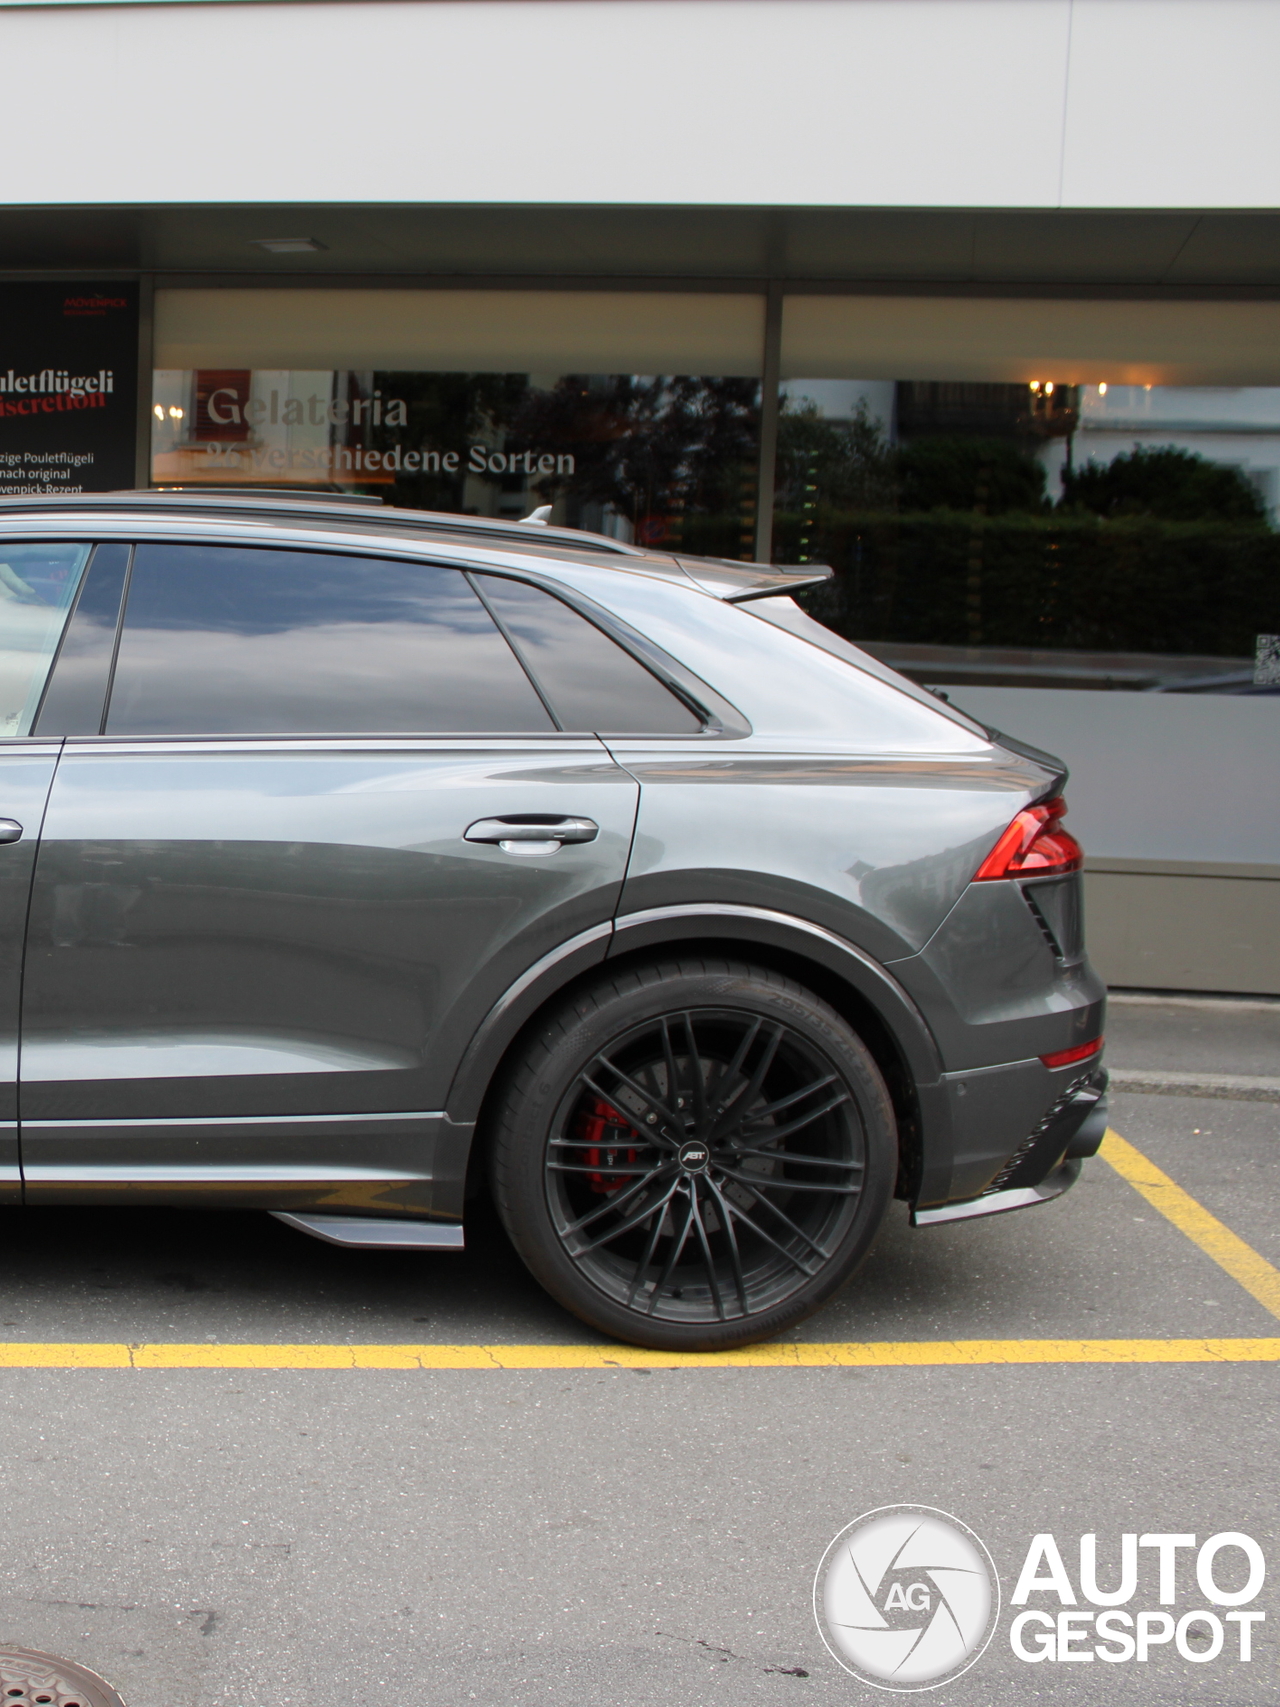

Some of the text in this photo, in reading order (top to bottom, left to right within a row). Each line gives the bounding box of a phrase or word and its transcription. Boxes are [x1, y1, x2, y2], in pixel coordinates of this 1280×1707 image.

[207, 388, 408, 427] Gelateria
[24, 451, 94, 467] Pouletflügeli
[249, 443, 460, 472] verschiedene
[467, 445, 575, 475] Sorten
[0, 467, 71, 482] nach original
[682, 1151, 705, 1161] ABT
